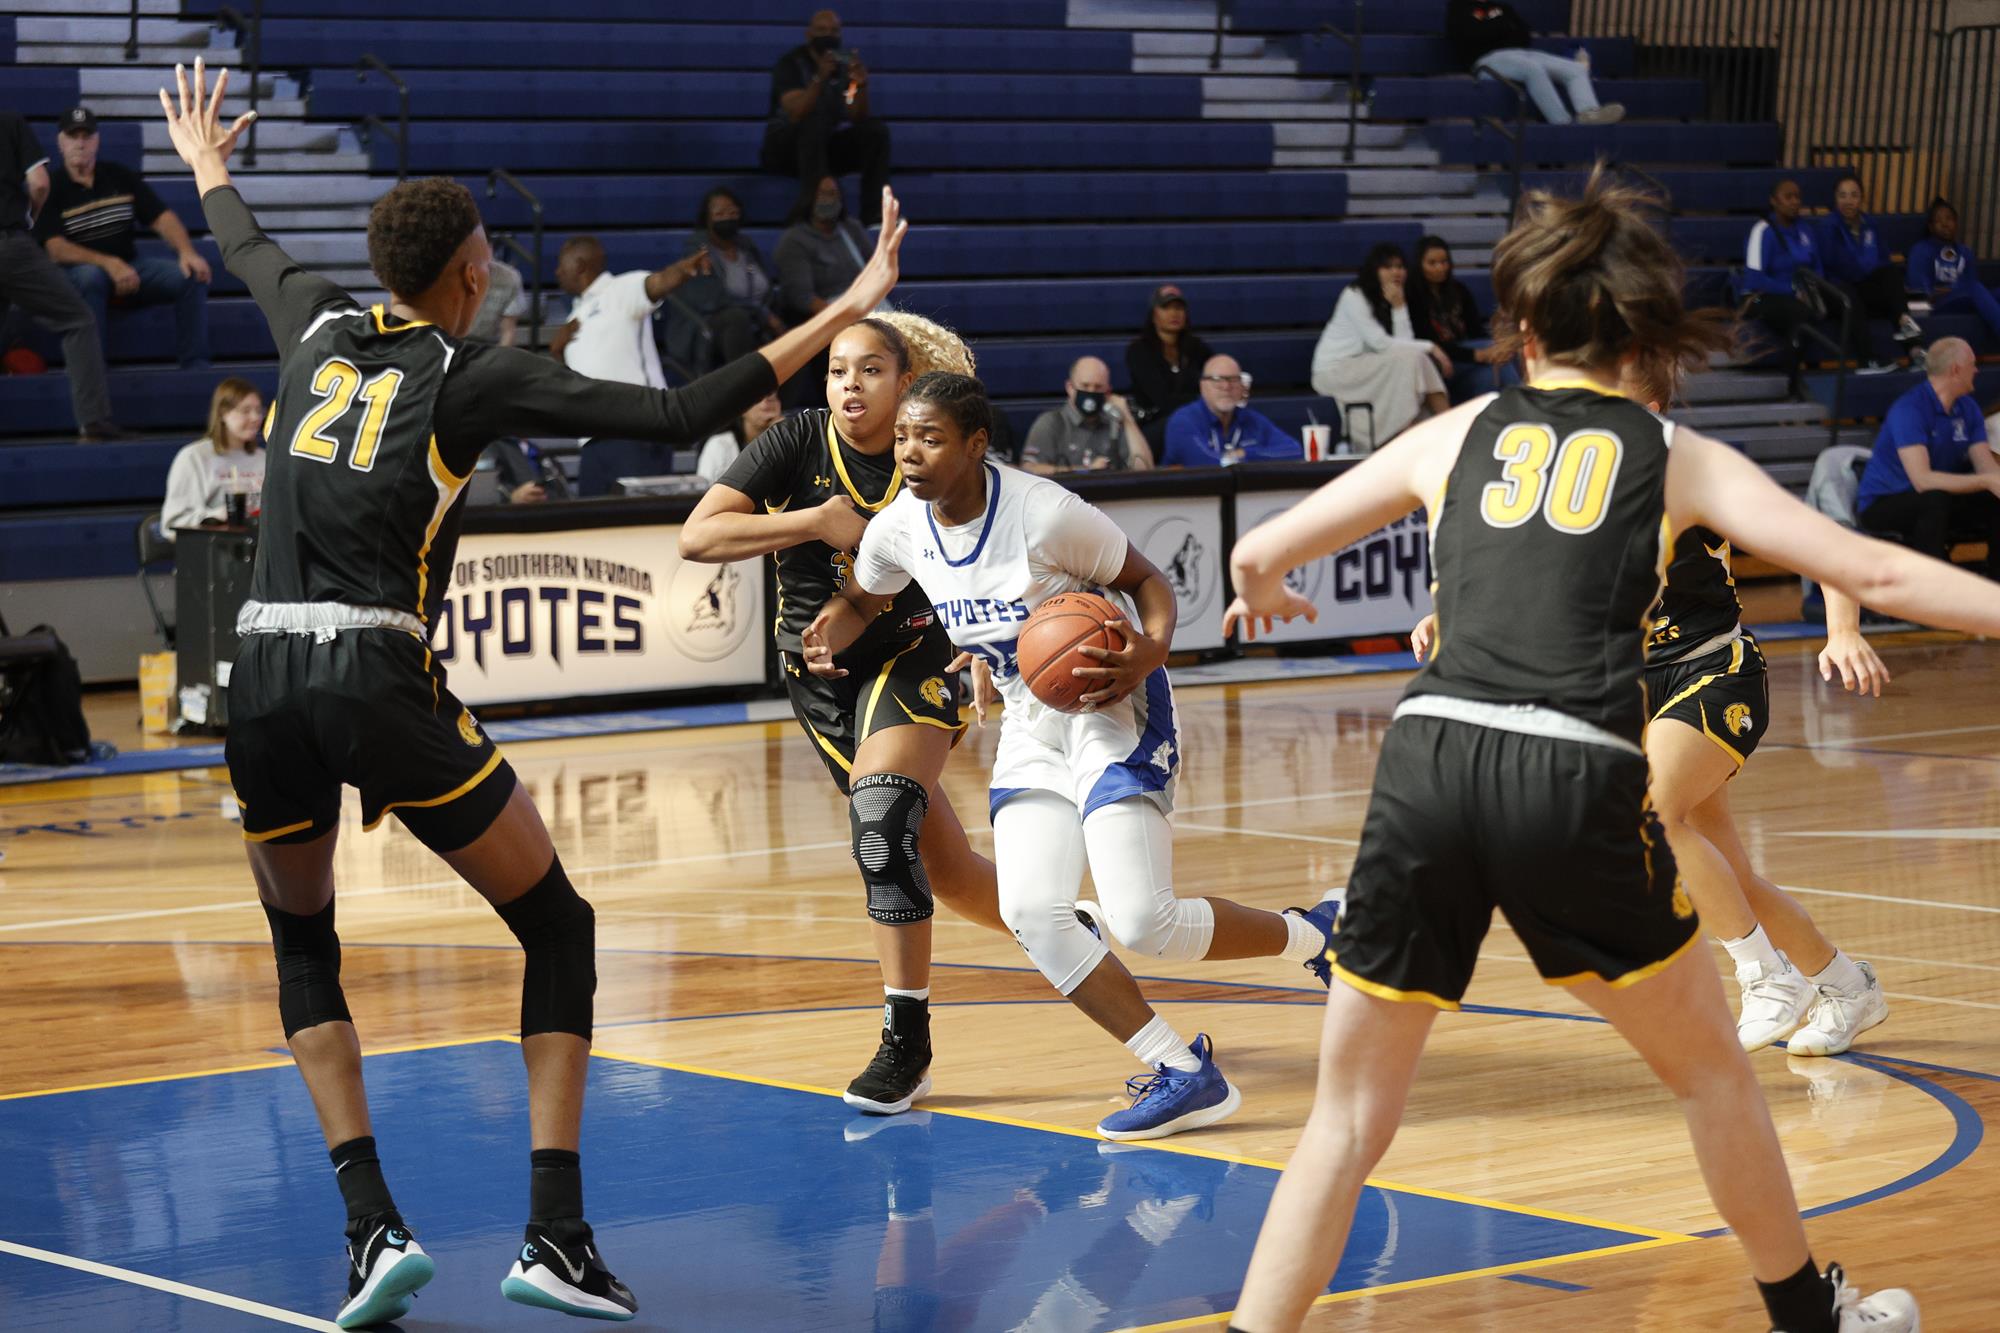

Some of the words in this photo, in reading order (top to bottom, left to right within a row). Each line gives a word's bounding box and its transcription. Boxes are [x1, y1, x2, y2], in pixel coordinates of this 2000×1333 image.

[289, 356, 404, 473] 21
[1480, 421, 1624, 535] 30
[456, 560, 477, 587] OF
[483, 554, 578, 582] SOUTHERN
[583, 558, 653, 596] NEVADA
[1335, 531, 1435, 611] COY
[856, 775, 893, 790] NEENCA
